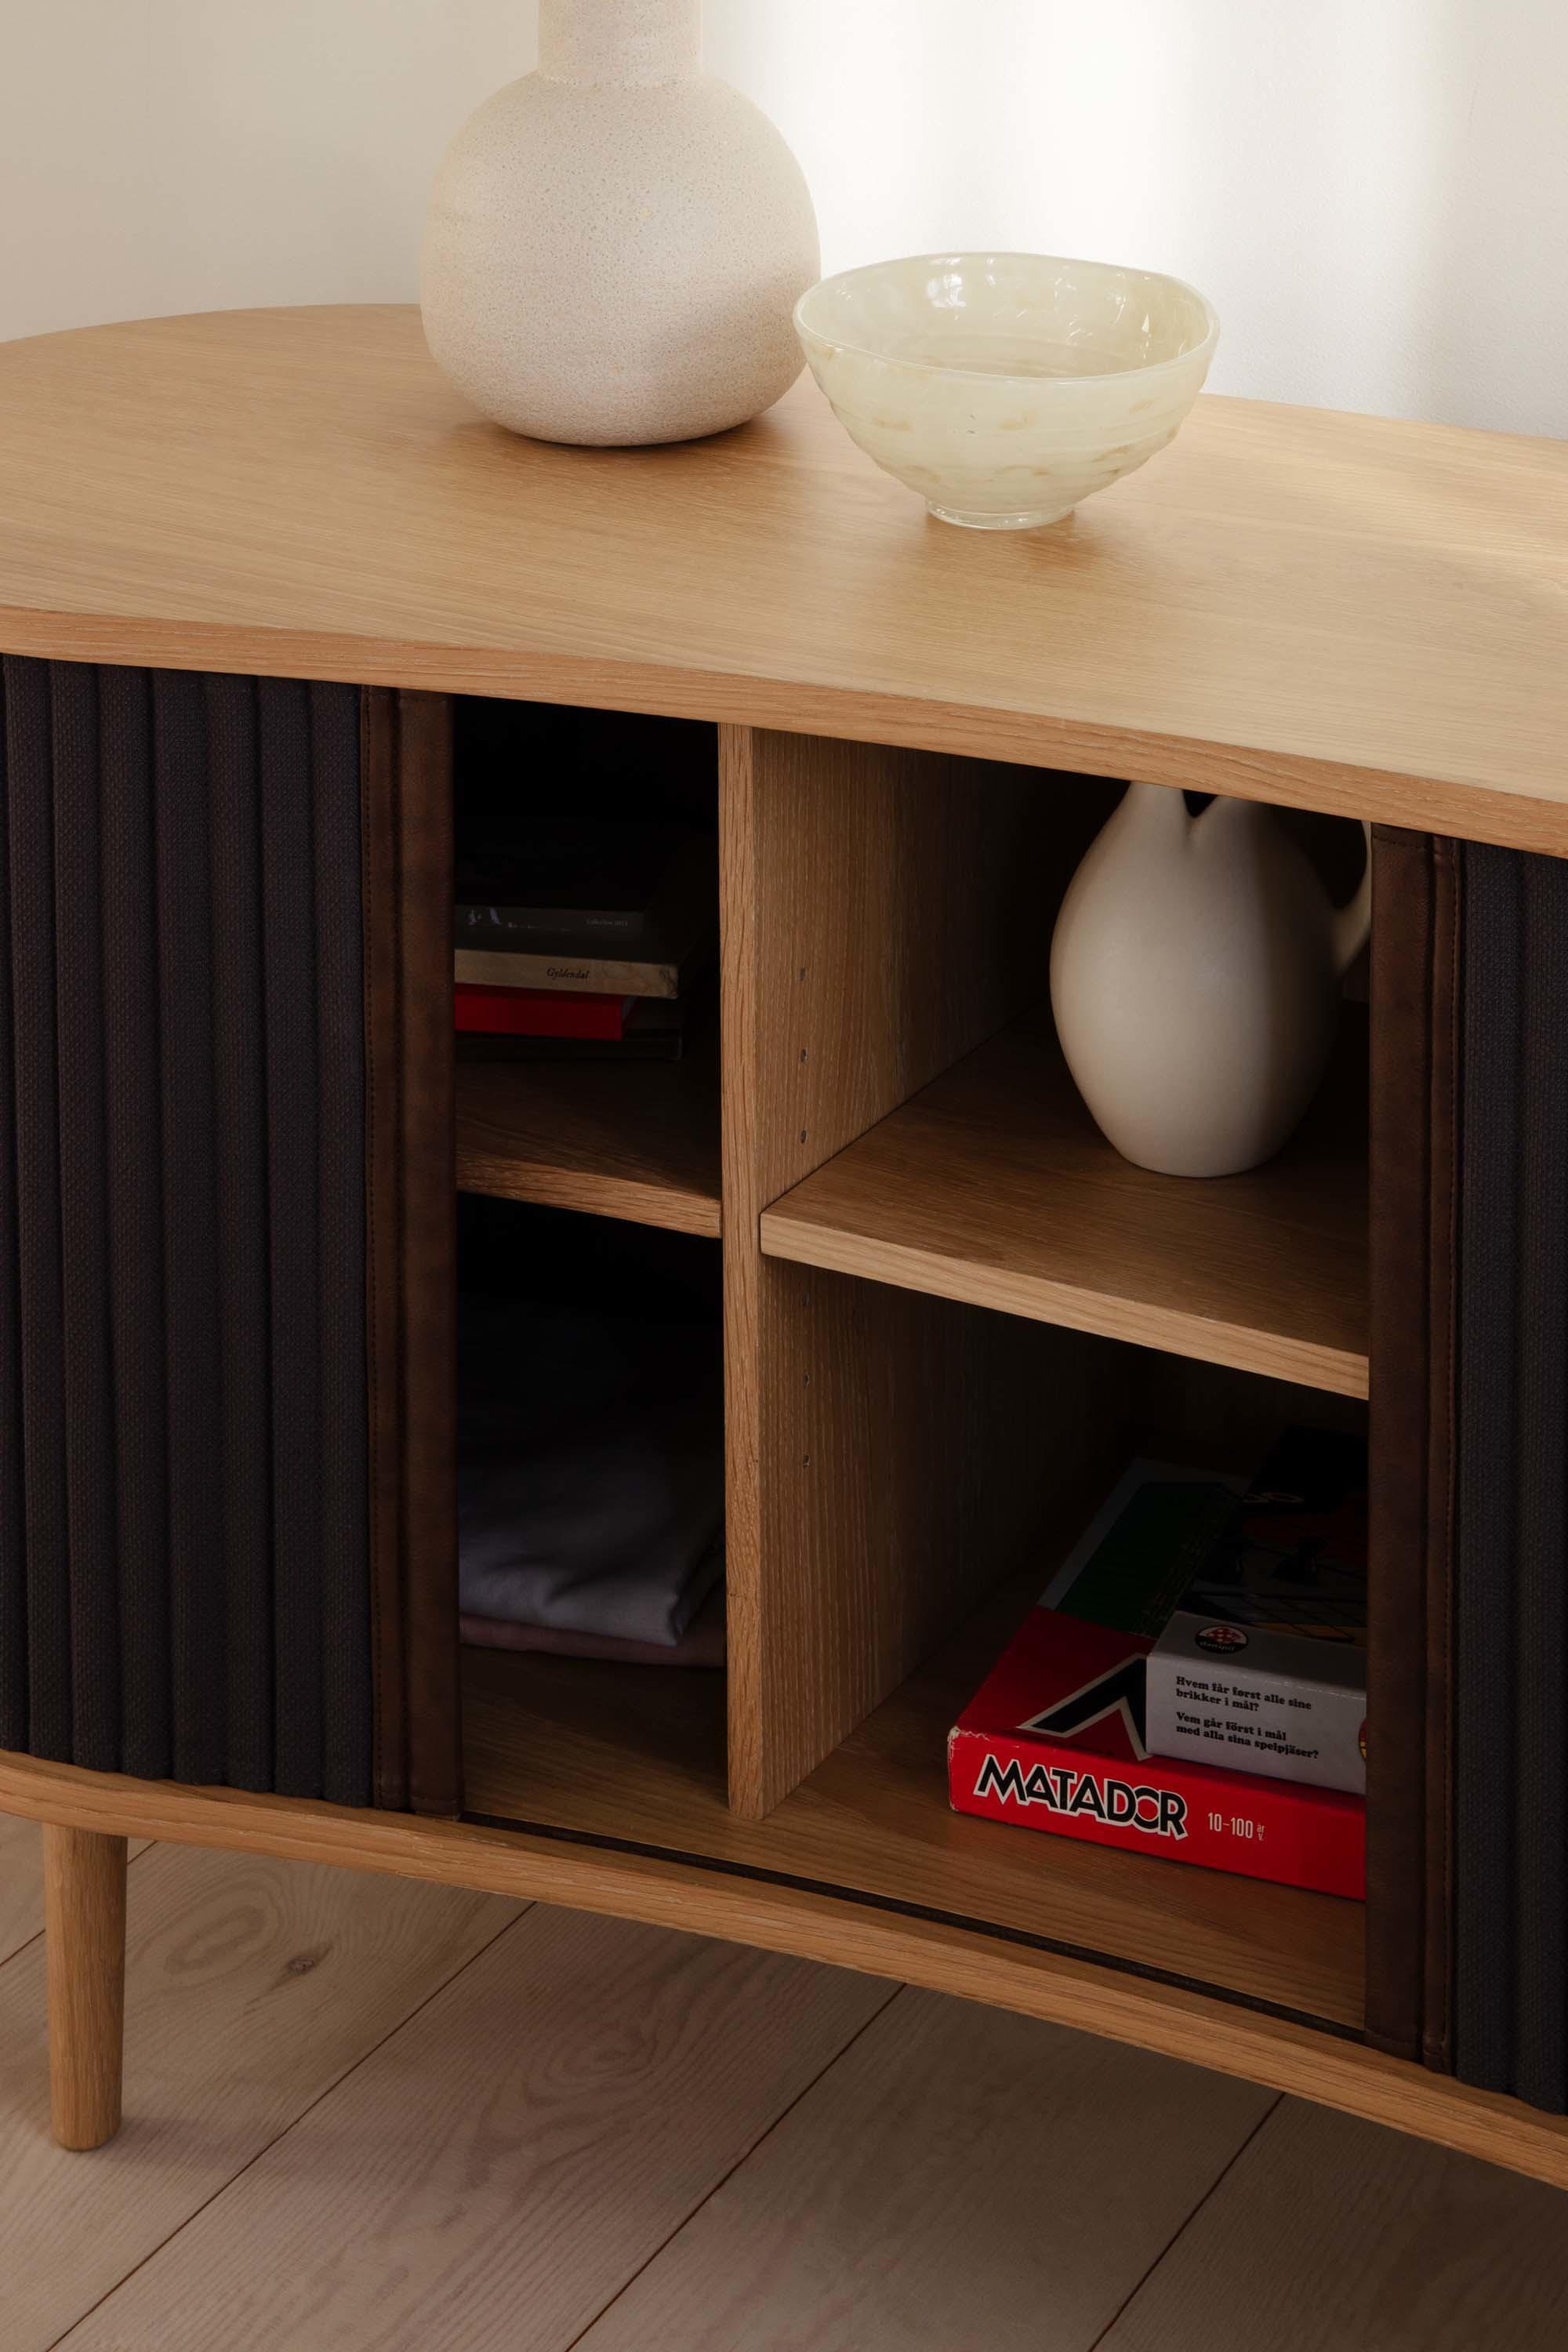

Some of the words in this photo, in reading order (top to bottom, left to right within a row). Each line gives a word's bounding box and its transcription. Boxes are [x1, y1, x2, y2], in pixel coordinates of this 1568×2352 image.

[546, 967, 590, 980] Gyldendal
[1176, 1676, 1209, 1690] Hvem
[1211, 1682, 1230, 1694] får
[1232, 1687, 1261, 1700] først
[1264, 1694, 1286, 1705] alle
[1288, 1700, 1312, 1710] sine
[1176, 1689, 1221, 1704] brikker
[1225, 1697, 1229, 1707] i
[1232, 1700, 1259, 1711] mål?
[1176, 1711, 1201, 1725] Vem
[1203, 1718, 1223, 1730] går
[1225, 1722, 1254, 1735] först
[1258, 1728, 1262, 1737] i
[1265, 1730, 1287, 1741] mål
[1176, 1725, 1200, 1736] med
[1203, 1730, 1225, 1740] alla
[1228, 1735, 1251, 1746] sina
[1254, 1741, 1319, 1759] spelpjäser?
[973, 1754, 1188, 1840] MATADOR
[1207, 1812, 1254, 1838] 10-100
